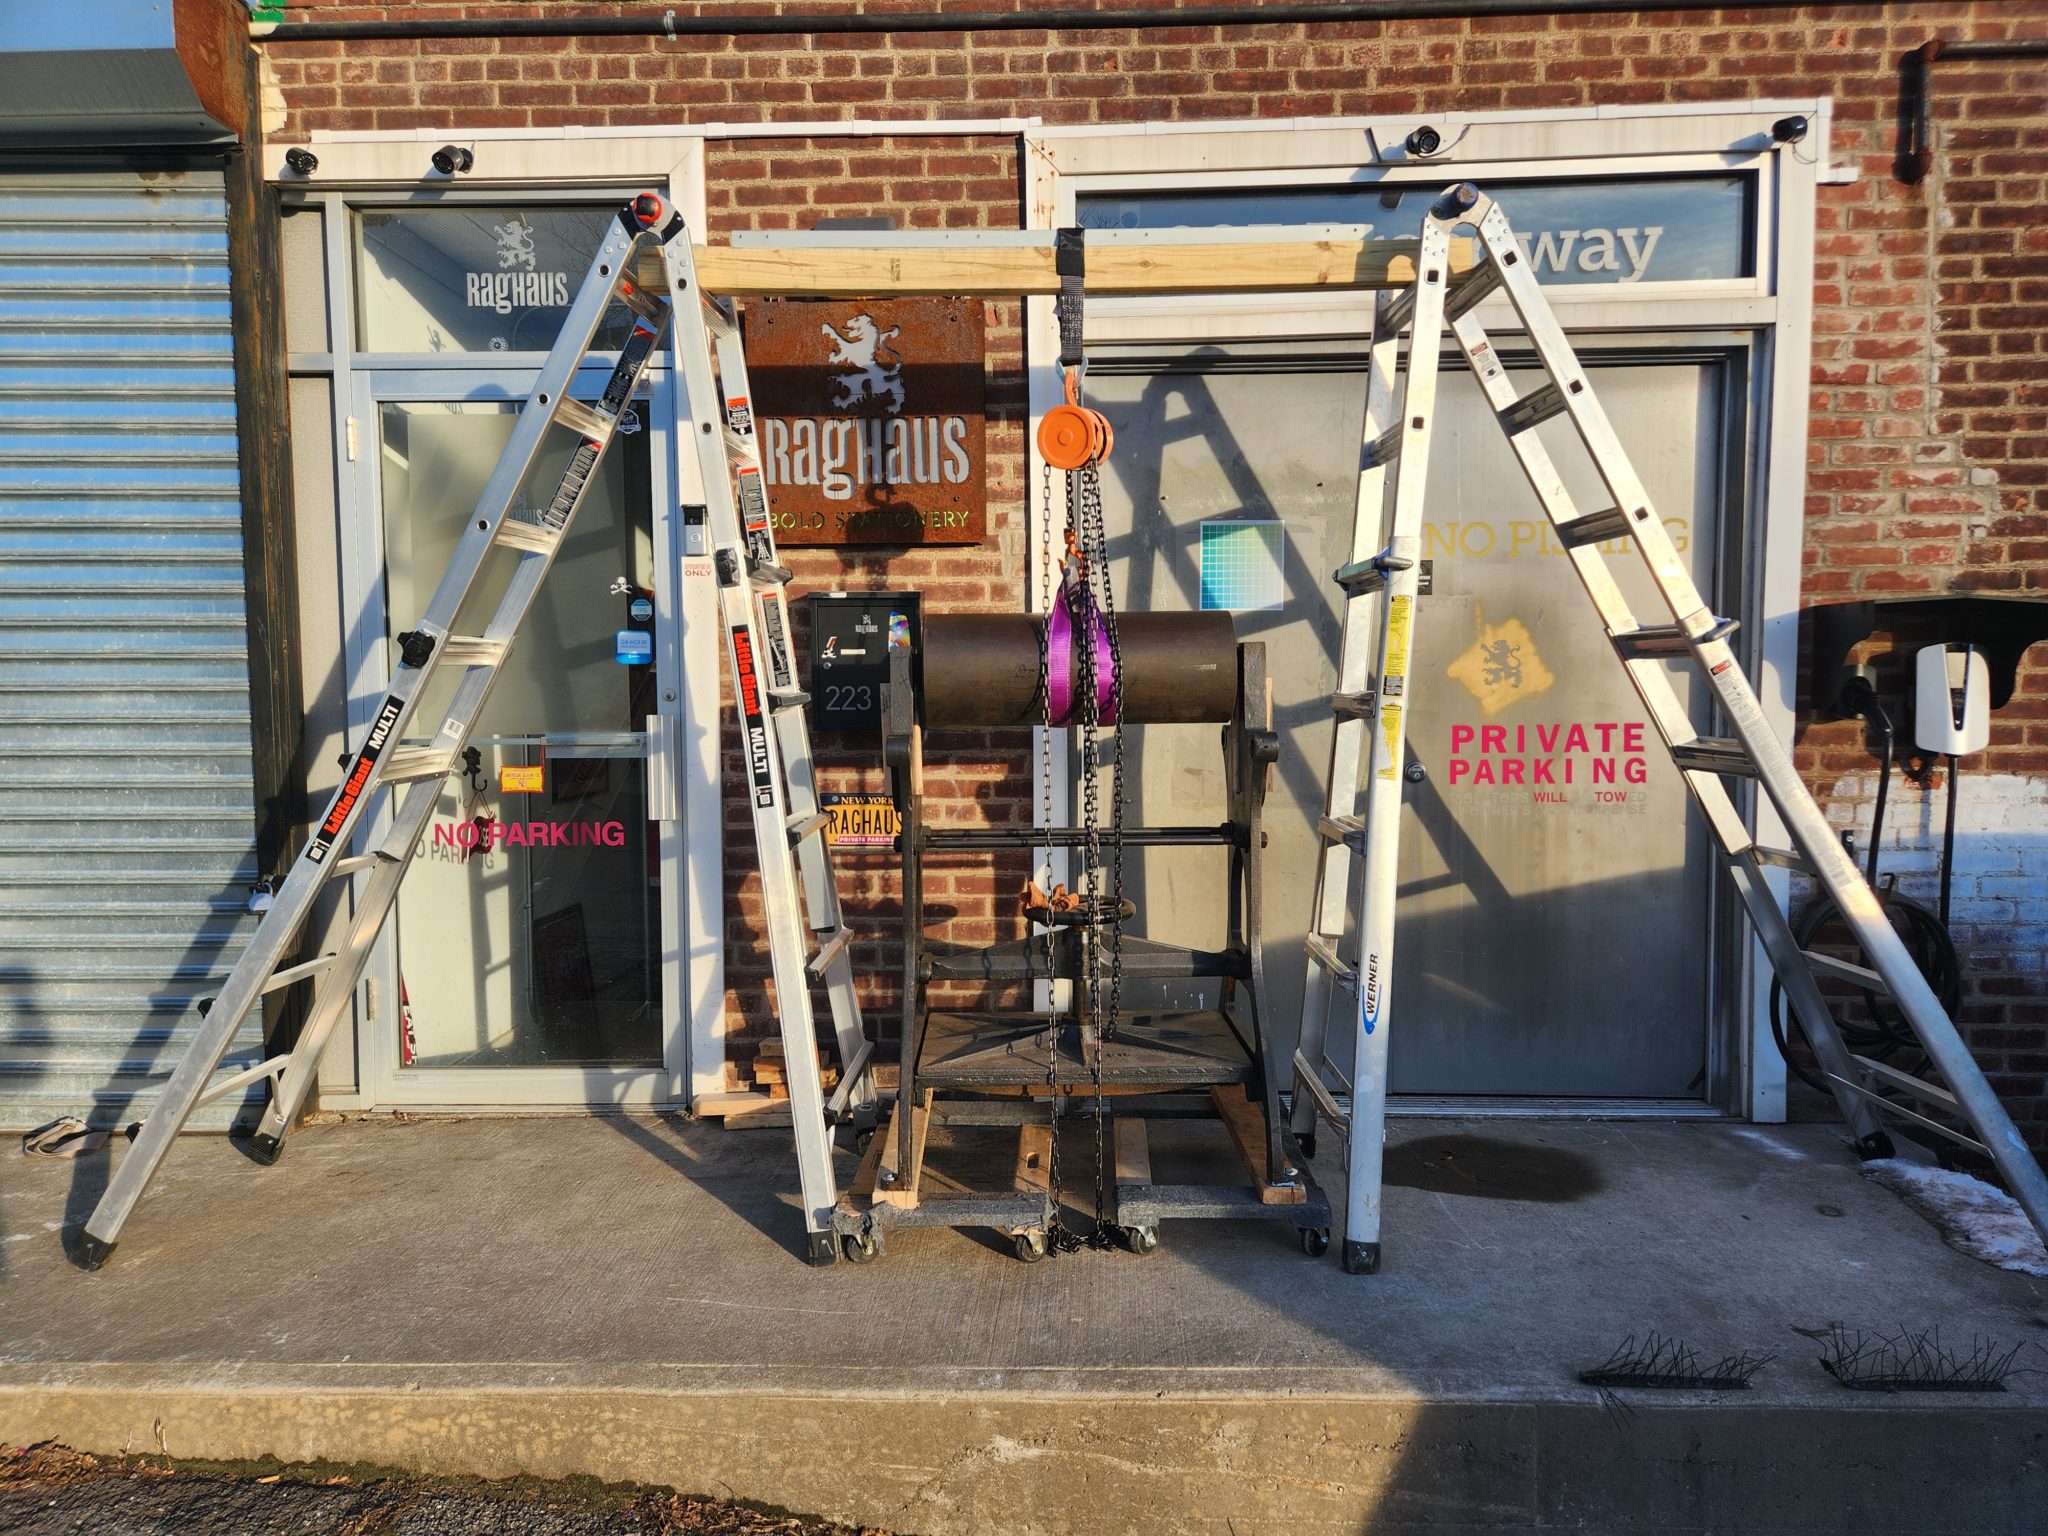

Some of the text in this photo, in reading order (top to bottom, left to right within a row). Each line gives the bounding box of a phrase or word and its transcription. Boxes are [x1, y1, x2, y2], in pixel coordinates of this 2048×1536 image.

[835, 510, 969, 530] STATIONERY
[1423, 521, 1496, 558] NO
[734, 631, 752, 675] Little
[740, 674, 761, 716] Giant
[825, 685, 872, 710] 223
[750, 726, 768, 774] MULTI
[1451, 723, 1645, 753] PRIVATE
[323, 704, 399, 836] Little Giant MULTI
[1450, 757, 1647, 784] PARKING
[841, 796, 894, 804] NEW YORK
[1533, 791, 1568, 802] WILL
[434, 822, 480, 848] NO
[488, 821, 625, 847] PARKING
[829, 809, 904, 834] RAGHAUS
[1366, 953, 1378, 1014] WERNER
